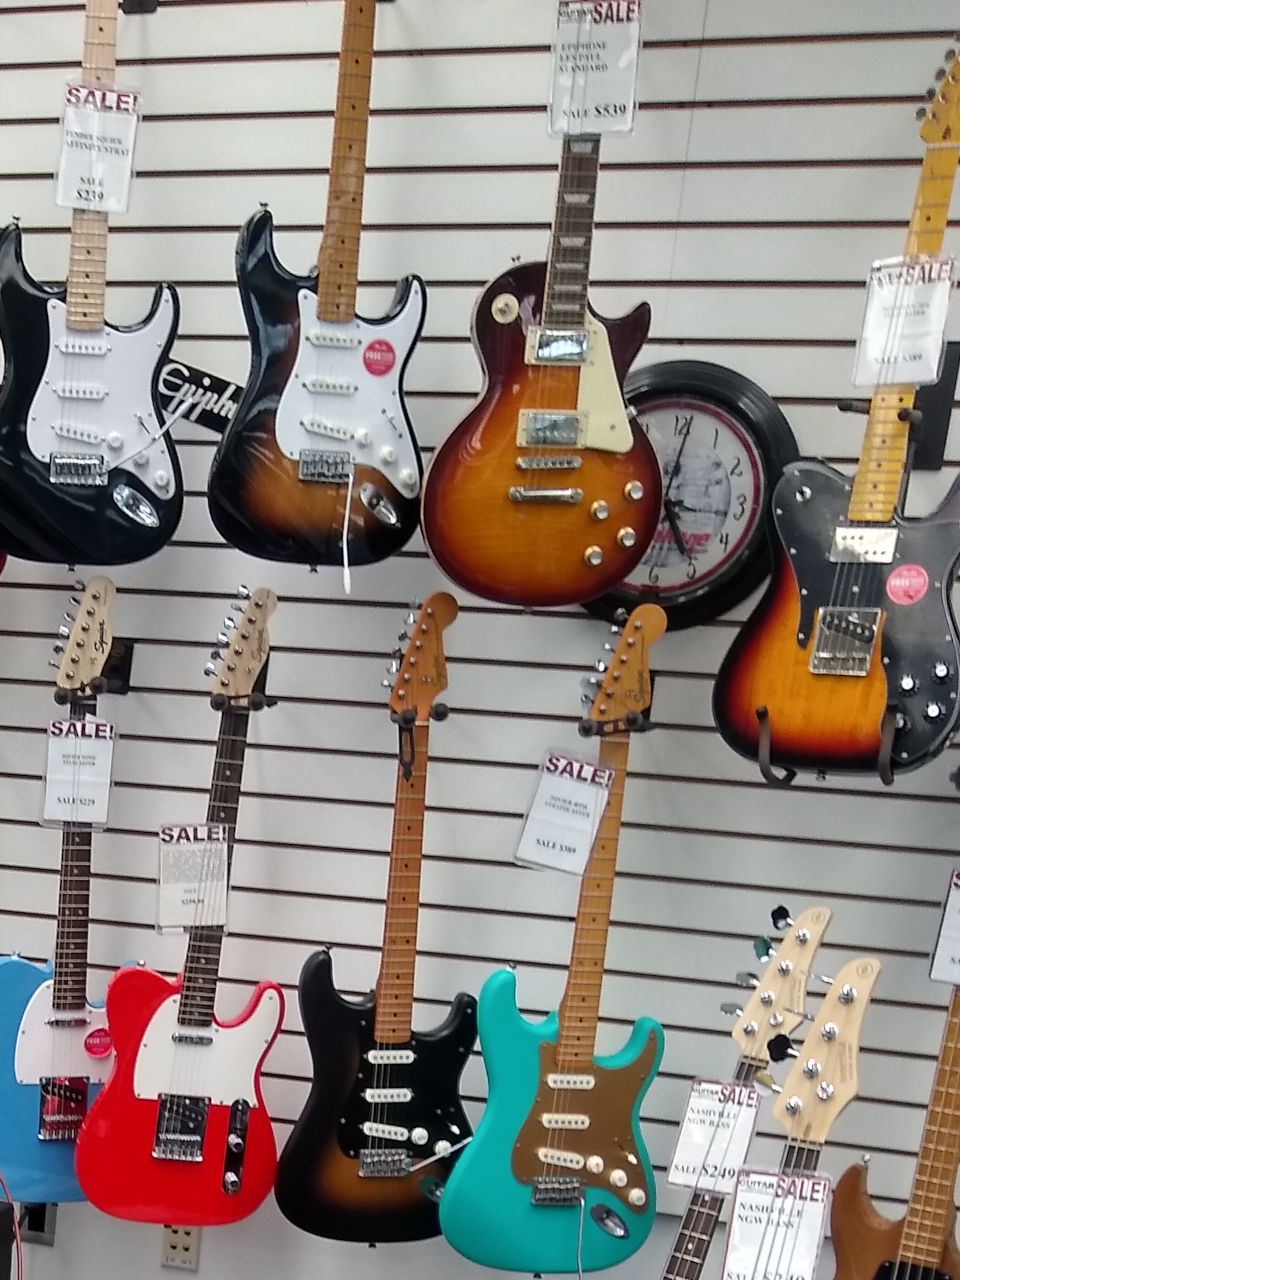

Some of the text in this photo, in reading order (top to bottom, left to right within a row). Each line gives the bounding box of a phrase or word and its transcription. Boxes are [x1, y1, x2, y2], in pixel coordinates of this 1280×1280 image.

[558, 63, 608, 73] STANDARD
[66, 86, 138, 114] SALE!
[593, 103, 626, 116] $539
[76, 188, 104, 203] $239
[158, 362, 239, 423] Epiph
[730, 457, 744, 478] 2
[733, 494, 748, 521] 3
[94, 619, 108, 655] Squier
[50, 720, 115, 740] SALE!
[545, 755, 613, 788] SALE!
[160, 826, 227, 844] SALE!
[692, 1085, 760, 1109] GUITAR SALE!
[689, 1107, 739, 1120] NASHVILLE
[673, 1163, 736, 1181] SALE $249
[739, 1177, 829, 1204] GUITAR SALE!
[736, 1214, 764, 1226] NGW
